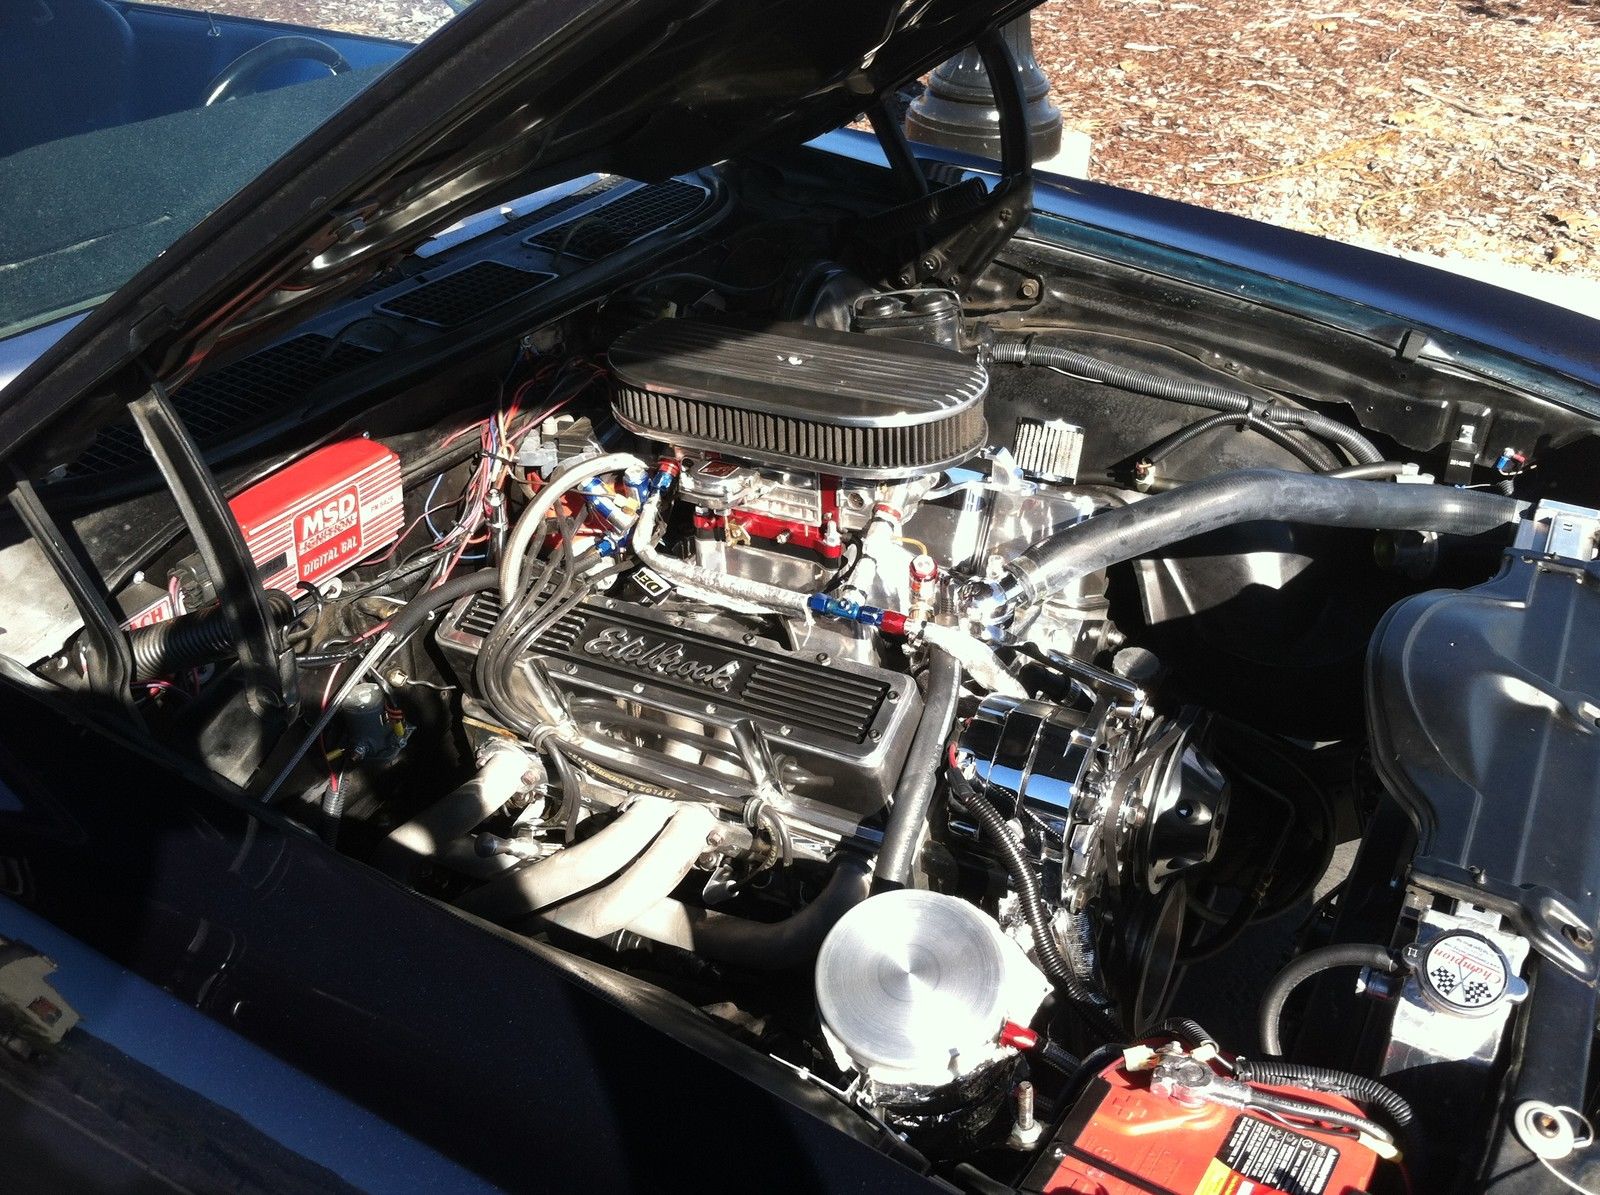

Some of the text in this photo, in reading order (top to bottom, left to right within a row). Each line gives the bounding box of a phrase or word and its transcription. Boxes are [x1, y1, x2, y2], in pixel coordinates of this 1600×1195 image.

[303, 494, 356, 542] MSD
[303, 547, 340, 577] DIGITAL
[584, 626, 741, 693] Edelbrock
[638, 785, 677, 799] TAYLOR
